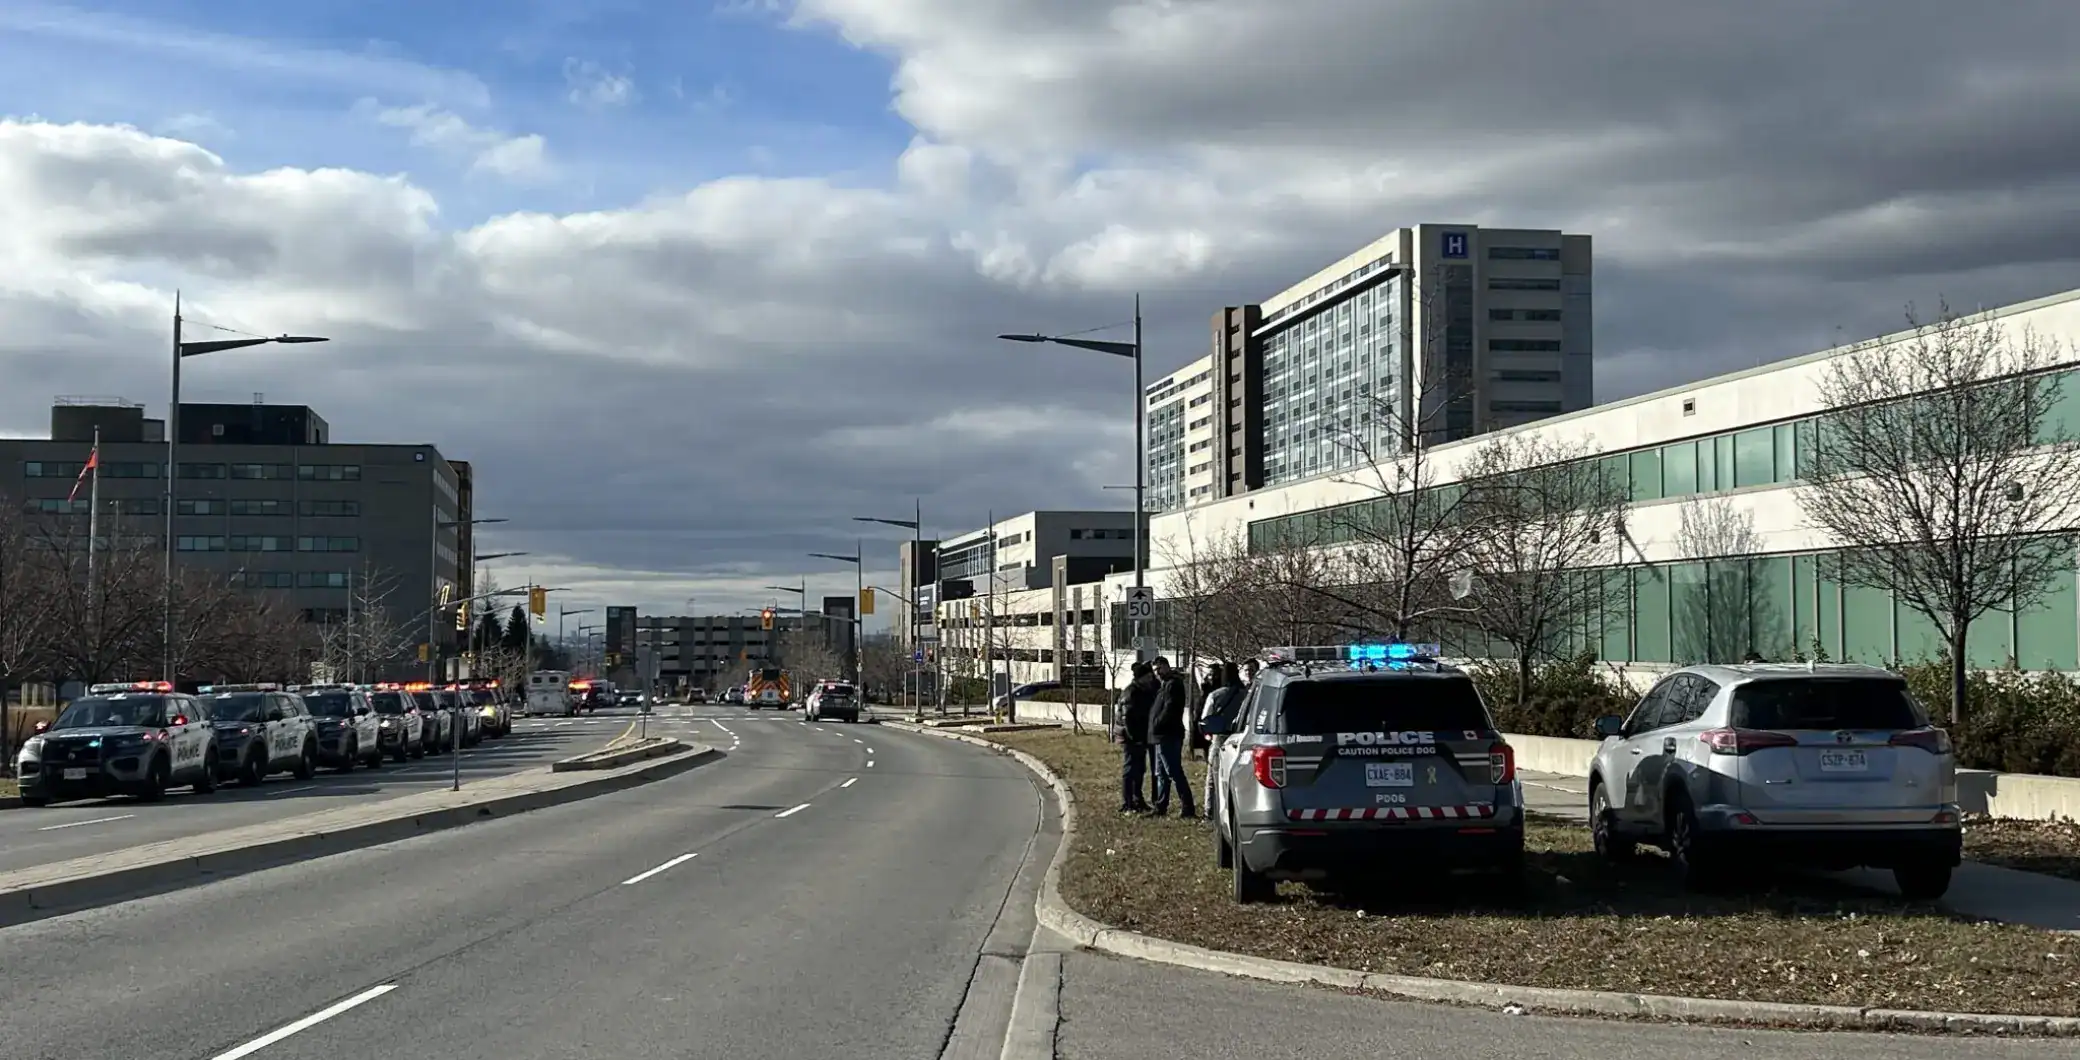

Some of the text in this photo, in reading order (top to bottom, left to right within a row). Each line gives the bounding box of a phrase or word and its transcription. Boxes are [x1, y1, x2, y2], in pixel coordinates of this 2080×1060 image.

[1449, 236, 1462, 253] H
[1129, 601, 1151, 616] 50
[1337, 731, 1435, 746] POLICE
[177, 743, 200, 762] POLICE
[1338, 746, 1436, 756] CAUTION POLICE DOG
